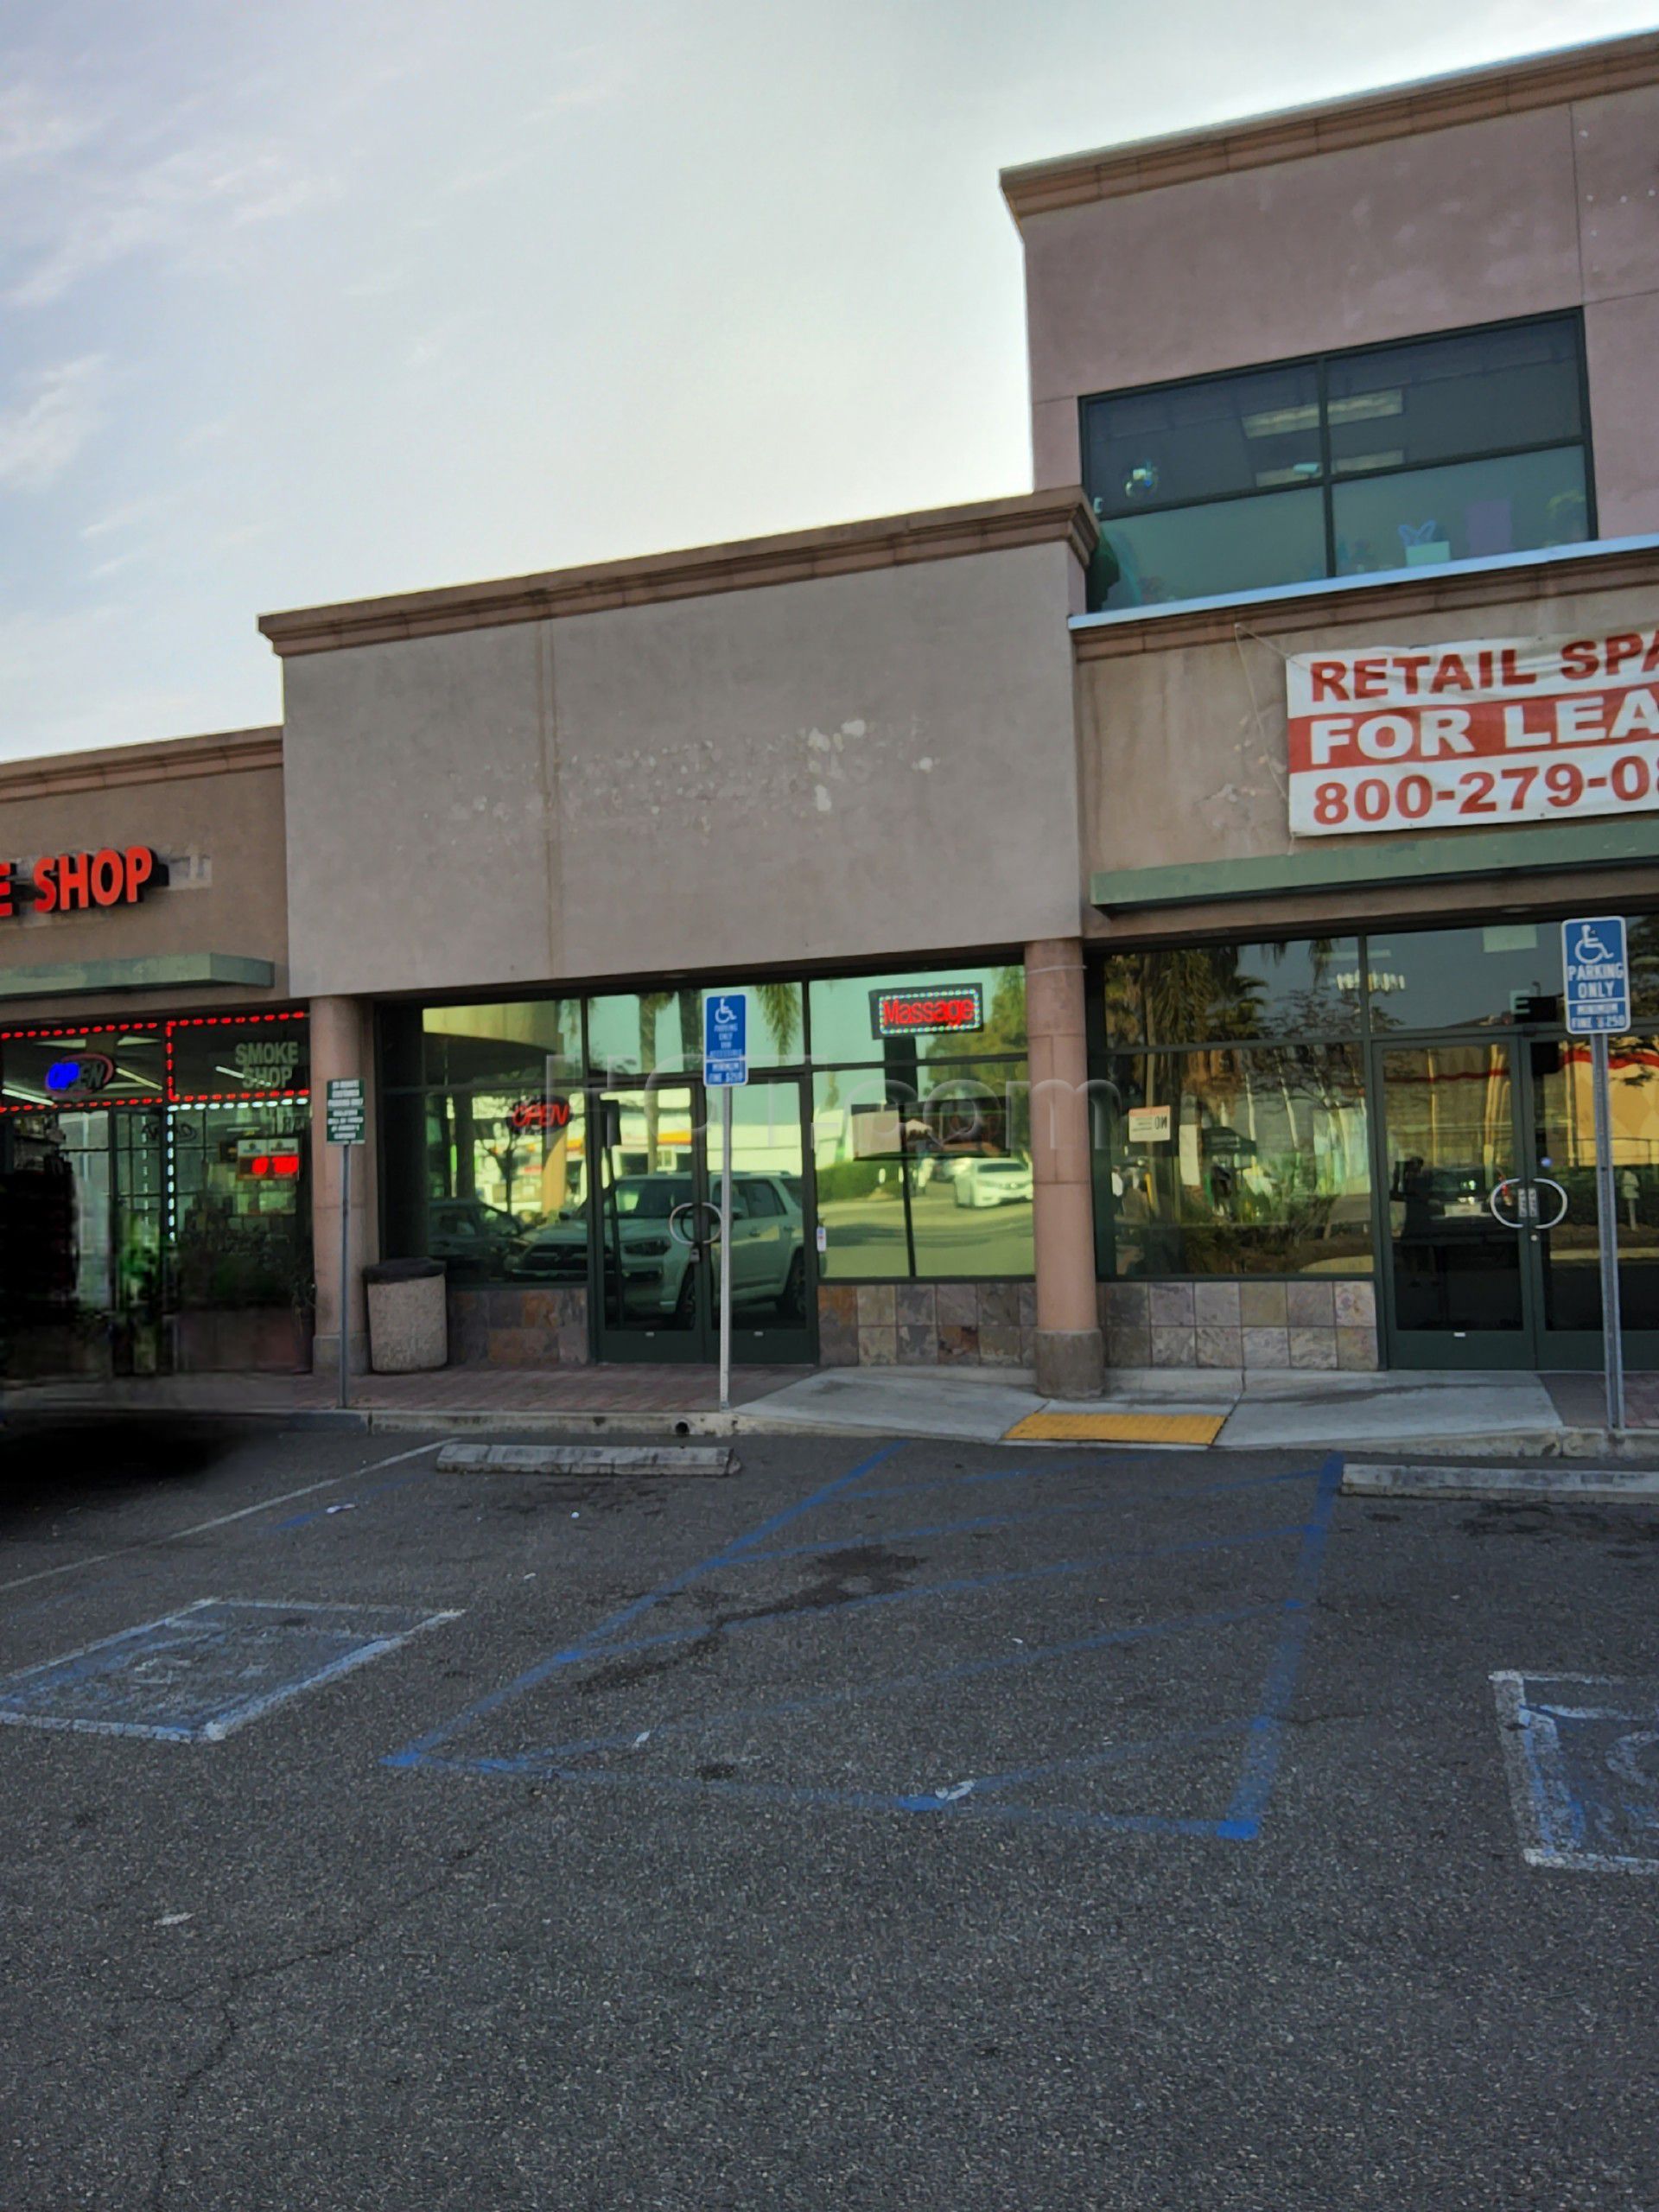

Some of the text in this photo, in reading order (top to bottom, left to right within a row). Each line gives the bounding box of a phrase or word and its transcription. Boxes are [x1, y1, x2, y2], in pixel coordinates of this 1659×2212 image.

[1310, 649, 1537, 702] RETAIL
[1310, 709, 1474, 766] FOR
[33, 845, 153, 912] SHOP
[1567, 963, 1624, 982] PARKING
[1578, 981, 1615, 999] ONLY
[883, 998, 975, 1027] Massage
[235, 1041, 299, 1065] SMOKE
[242, 1065, 293, 1088] SHOP
[512, 1103, 570, 1128] OPEN
